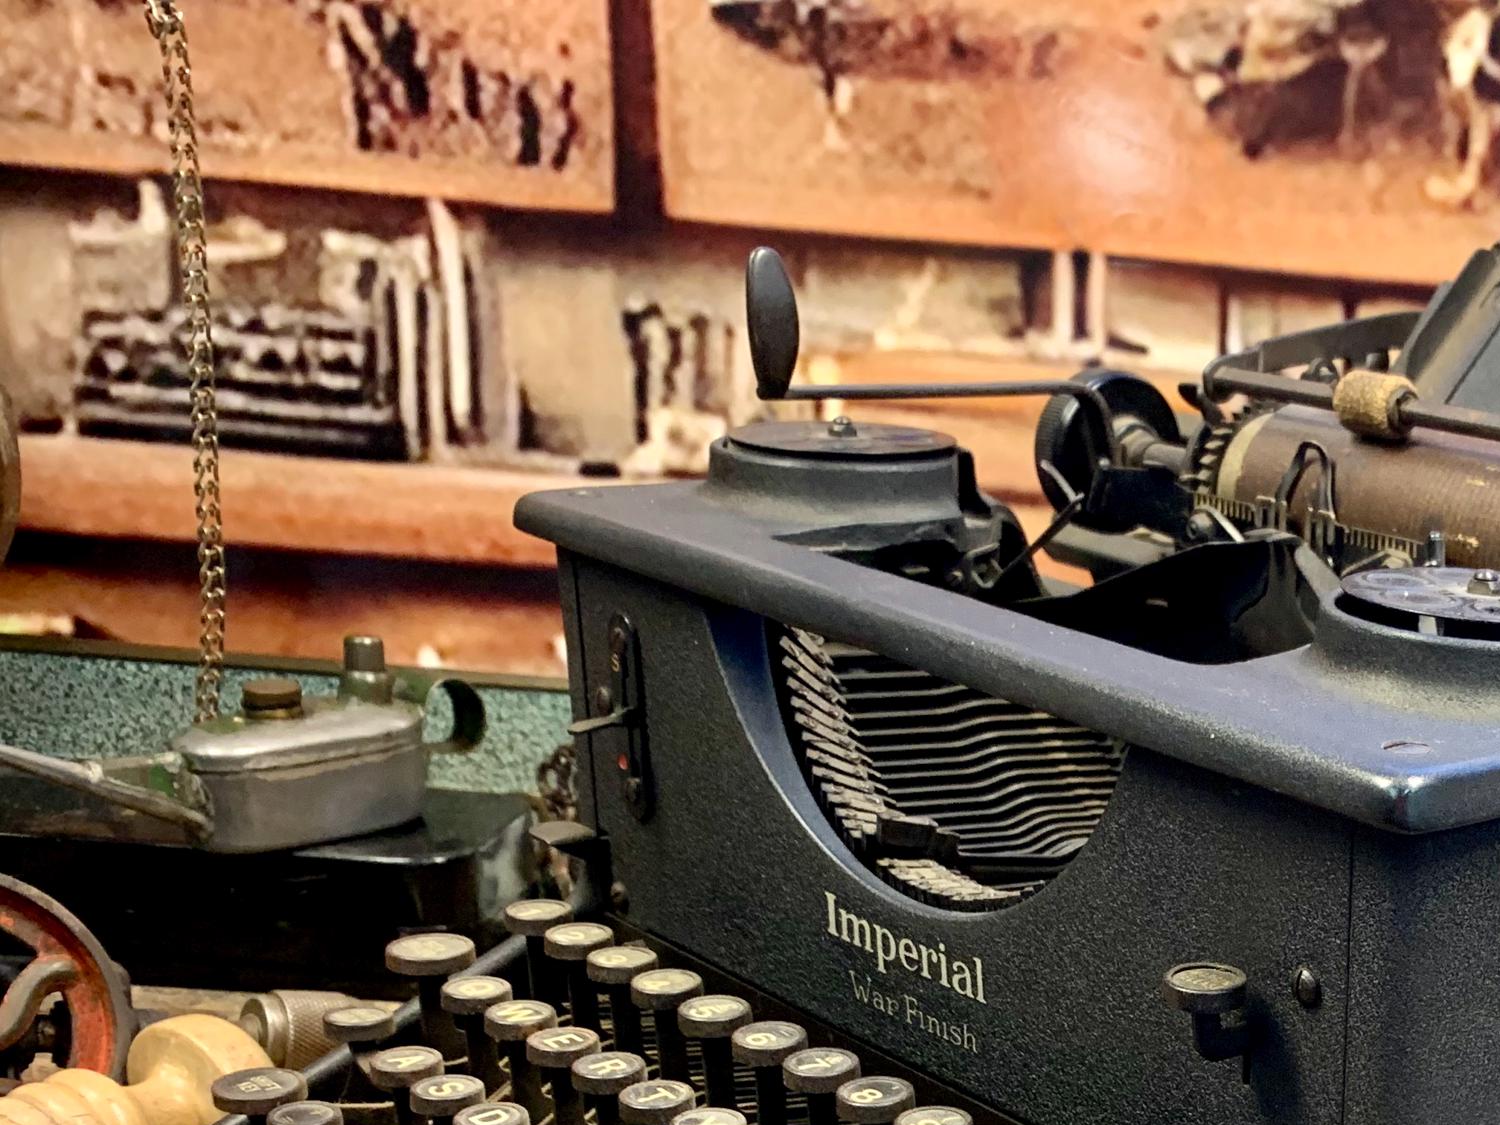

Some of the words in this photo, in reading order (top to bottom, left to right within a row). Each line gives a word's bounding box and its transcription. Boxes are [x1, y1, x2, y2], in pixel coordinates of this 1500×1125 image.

[824, 890, 988, 1005] Imperial
[495, 1004, 545, 1023] W
[849, 969, 899, 1016] War
[904, 994, 978, 1053] Finish
[542, 1033, 584, 1049] E
[385, 1055, 425, 1069] A
[588, 1057, 628, 1075] R
[427, 1081, 465, 1097] S
[637, 1086, 678, 1103] T
[850, 1088, 883, 1104] 8
